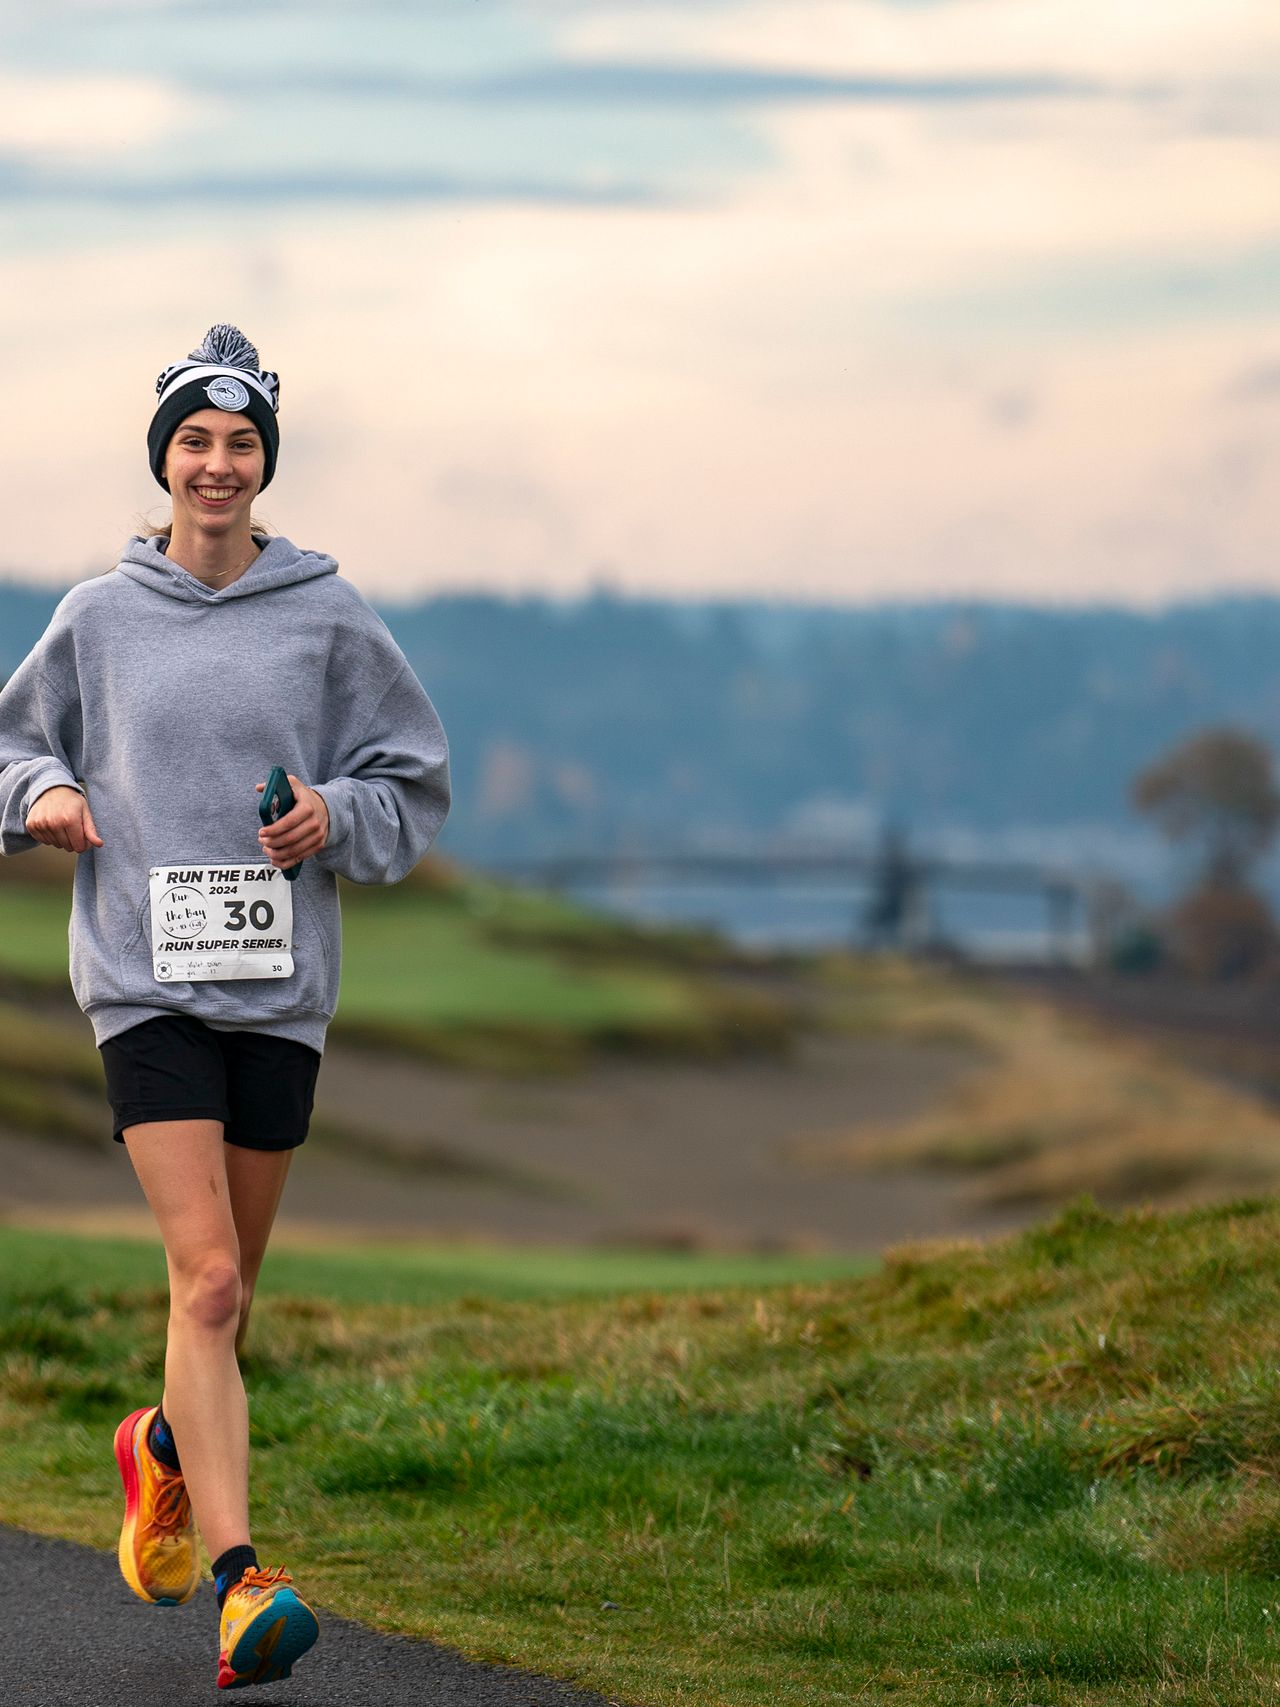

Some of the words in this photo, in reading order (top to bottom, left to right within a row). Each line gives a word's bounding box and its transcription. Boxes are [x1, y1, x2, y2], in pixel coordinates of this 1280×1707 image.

[166, 871, 204, 884] RUN
[208, 870, 240, 882] THE
[244, 870, 277, 882] BAY
[209, 886, 238, 894] 2024
[224, 900, 274, 931] 30
[165, 941, 194, 951] RUN
[196, 940, 240, 950] SUPER
[242, 938, 283, 949] SERIES
